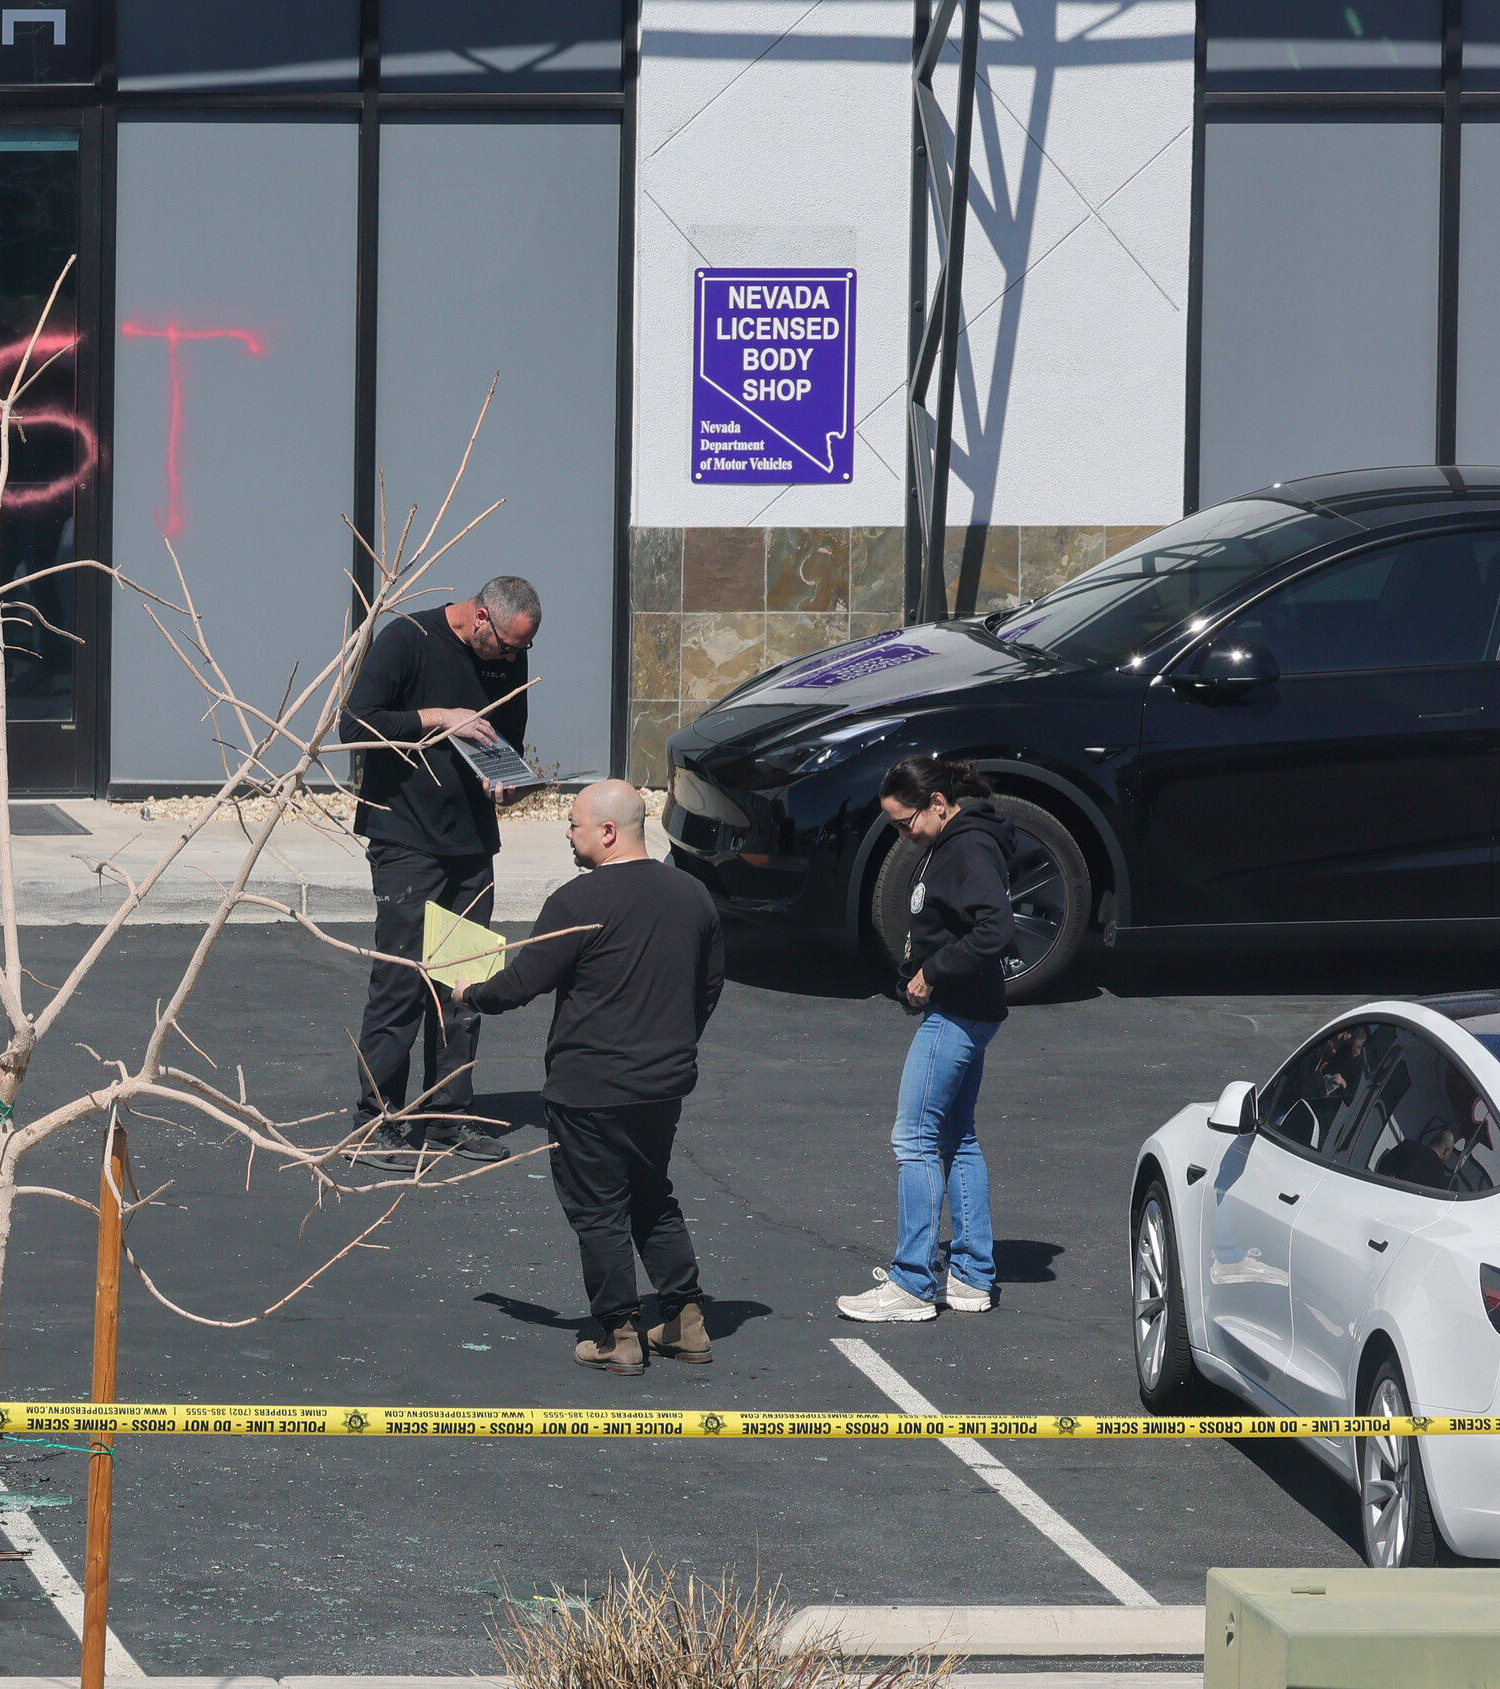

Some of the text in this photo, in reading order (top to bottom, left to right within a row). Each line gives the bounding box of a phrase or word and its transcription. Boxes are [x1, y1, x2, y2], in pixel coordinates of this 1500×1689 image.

[728, 285, 831, 310] NEVADA
[716, 317, 840, 340] LICENSED
[742, 347, 814, 371] BODY
[742, 378, 812, 401] SHOP
[700, 420, 741, 434] Nevada
[699, 438, 765, 454] Department
[699, 457, 793, 470] of Motor Vehicles
[185, 1408, 227, 1416] 385-5555
[229, 1408, 252, 1416] (702)
[254, 1409, 298, 1417] STOPPERS
[300, 1409, 328, 1417] CRIME
[26, 1418, 326, 1433] POLICE LINE DO NOT CROSS CRIME SCENE
[384, 1421, 683, 1435] POLICE LINE DO NOT CROSS CRIME SCENE
[741, 1421, 1038, 1435] POLICE LINE DO NOT CROSS CRIME SCENE
[1095, 1419, 1391, 1435] POLICE LINE DO NOT CROSS CRIME SCENE
[1448, 1418, 1492, 1431] SCENE
